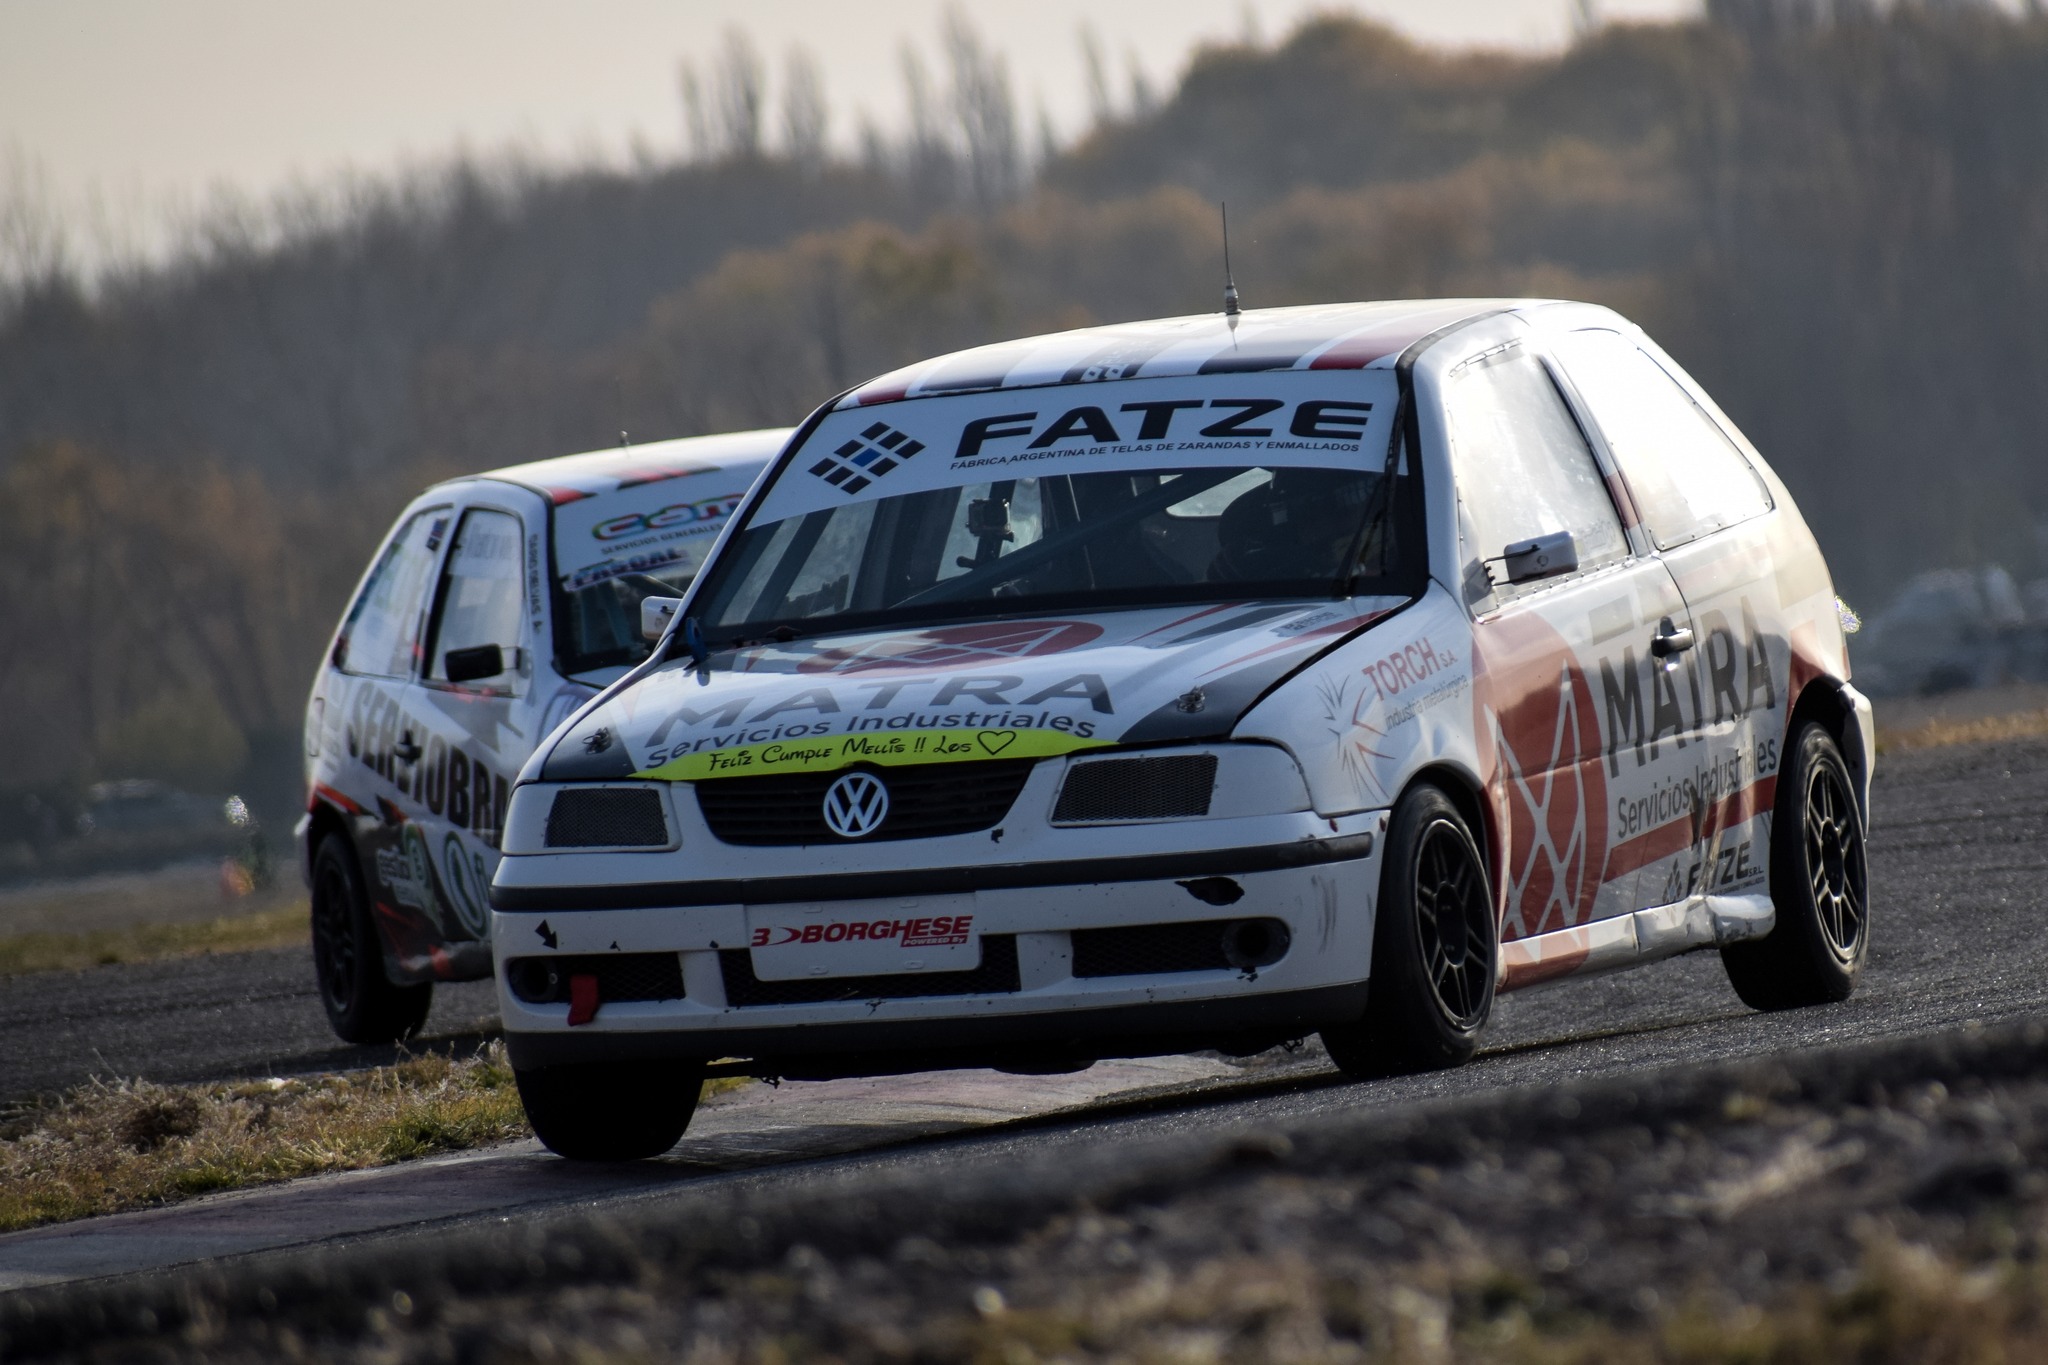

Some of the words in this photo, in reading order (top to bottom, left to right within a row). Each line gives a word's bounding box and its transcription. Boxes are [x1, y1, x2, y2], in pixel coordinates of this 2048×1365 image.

[955, 399, 1373, 458] FATZE
[1089, 446, 1107, 455] DE
[1112, 443, 1153, 454] TELAS
[1156, 443, 1175, 451] DE
[1178, 441, 1250, 450] ZARANDAS
[1255, 441, 1264, 449] Y
[1267, 441, 1360, 452] ENMALLADOS
[1362, 636, 1441, 701] TORCH
[1599, 594, 1776, 779] MATRA
[644, 673, 1115, 748] MATRA
[645, 721, 832, 769] Servicios
[846, 711, 1096, 739] Industriales
[1618, 775, 1692, 839] Servicios
[1695, 734, 1777, 799] Industiales
[800, 915, 973, 944] BORGHESE
[902, 936, 950, 946] POWERED
